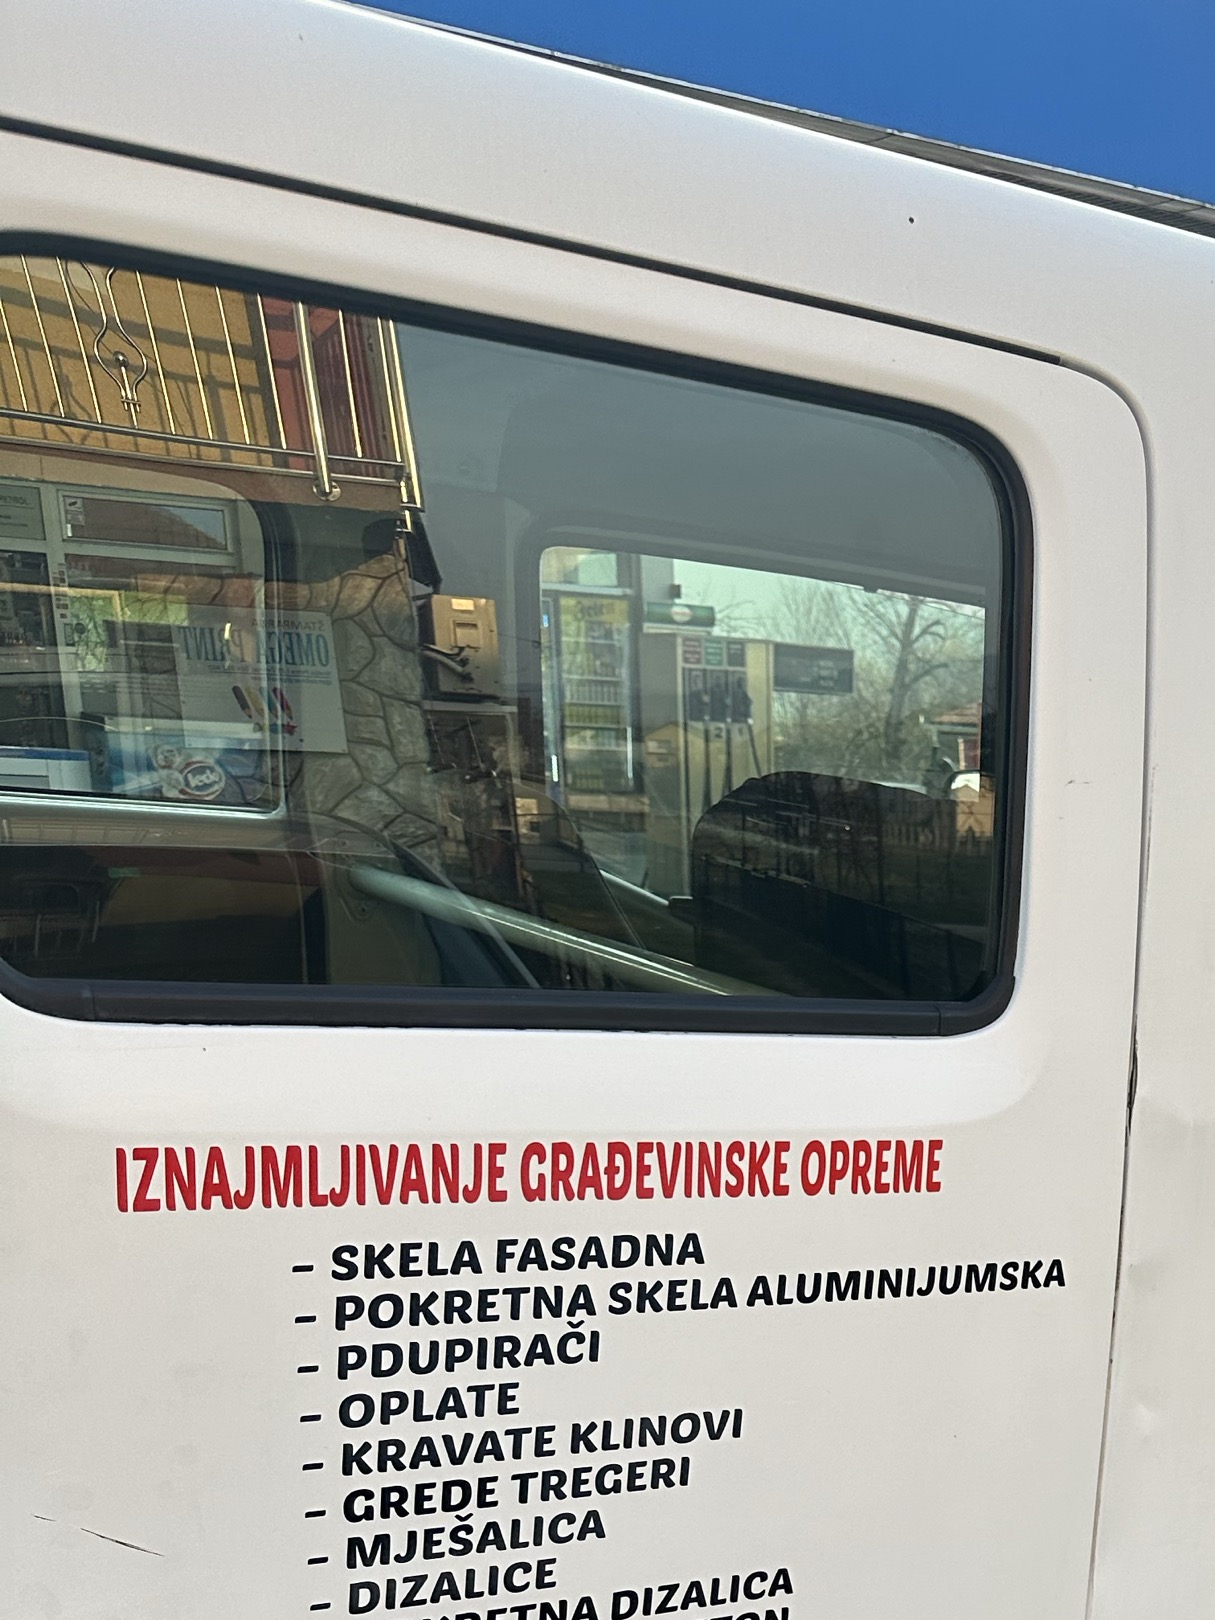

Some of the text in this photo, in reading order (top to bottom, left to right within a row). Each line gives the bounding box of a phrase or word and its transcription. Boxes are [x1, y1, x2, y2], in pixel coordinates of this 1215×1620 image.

[115, 1139, 944, 1213] IZNAJMLJIVANJE GRAĐEVINSKE OPREME
[331, 1240, 483, 1281] SKELA
[496, 1232, 705, 1274] FASADNA
[334, 1284, 597, 1331] POKRETNA
[608, 1277, 738, 1316] SKELA
[746, 1258, 1066, 1307] ALUMINIJUMSKA
[337, 1319, 600, 1381] PDUPIRAČI
[338, 1381, 520, 1429] OPLATE
[341, 1425, 556, 1477] KRAVATE
[570, 1408, 743, 1455] KLINOVI
[343, 1475, 499, 1524] GREDE
[510, 1456, 690, 1505] TREGERI
[346, 1509, 606, 1570] MJEŠALICA
[348, 1557, 557, 1615] DIZALICE
[611, 1567, 794, 1620] DIZALICA
